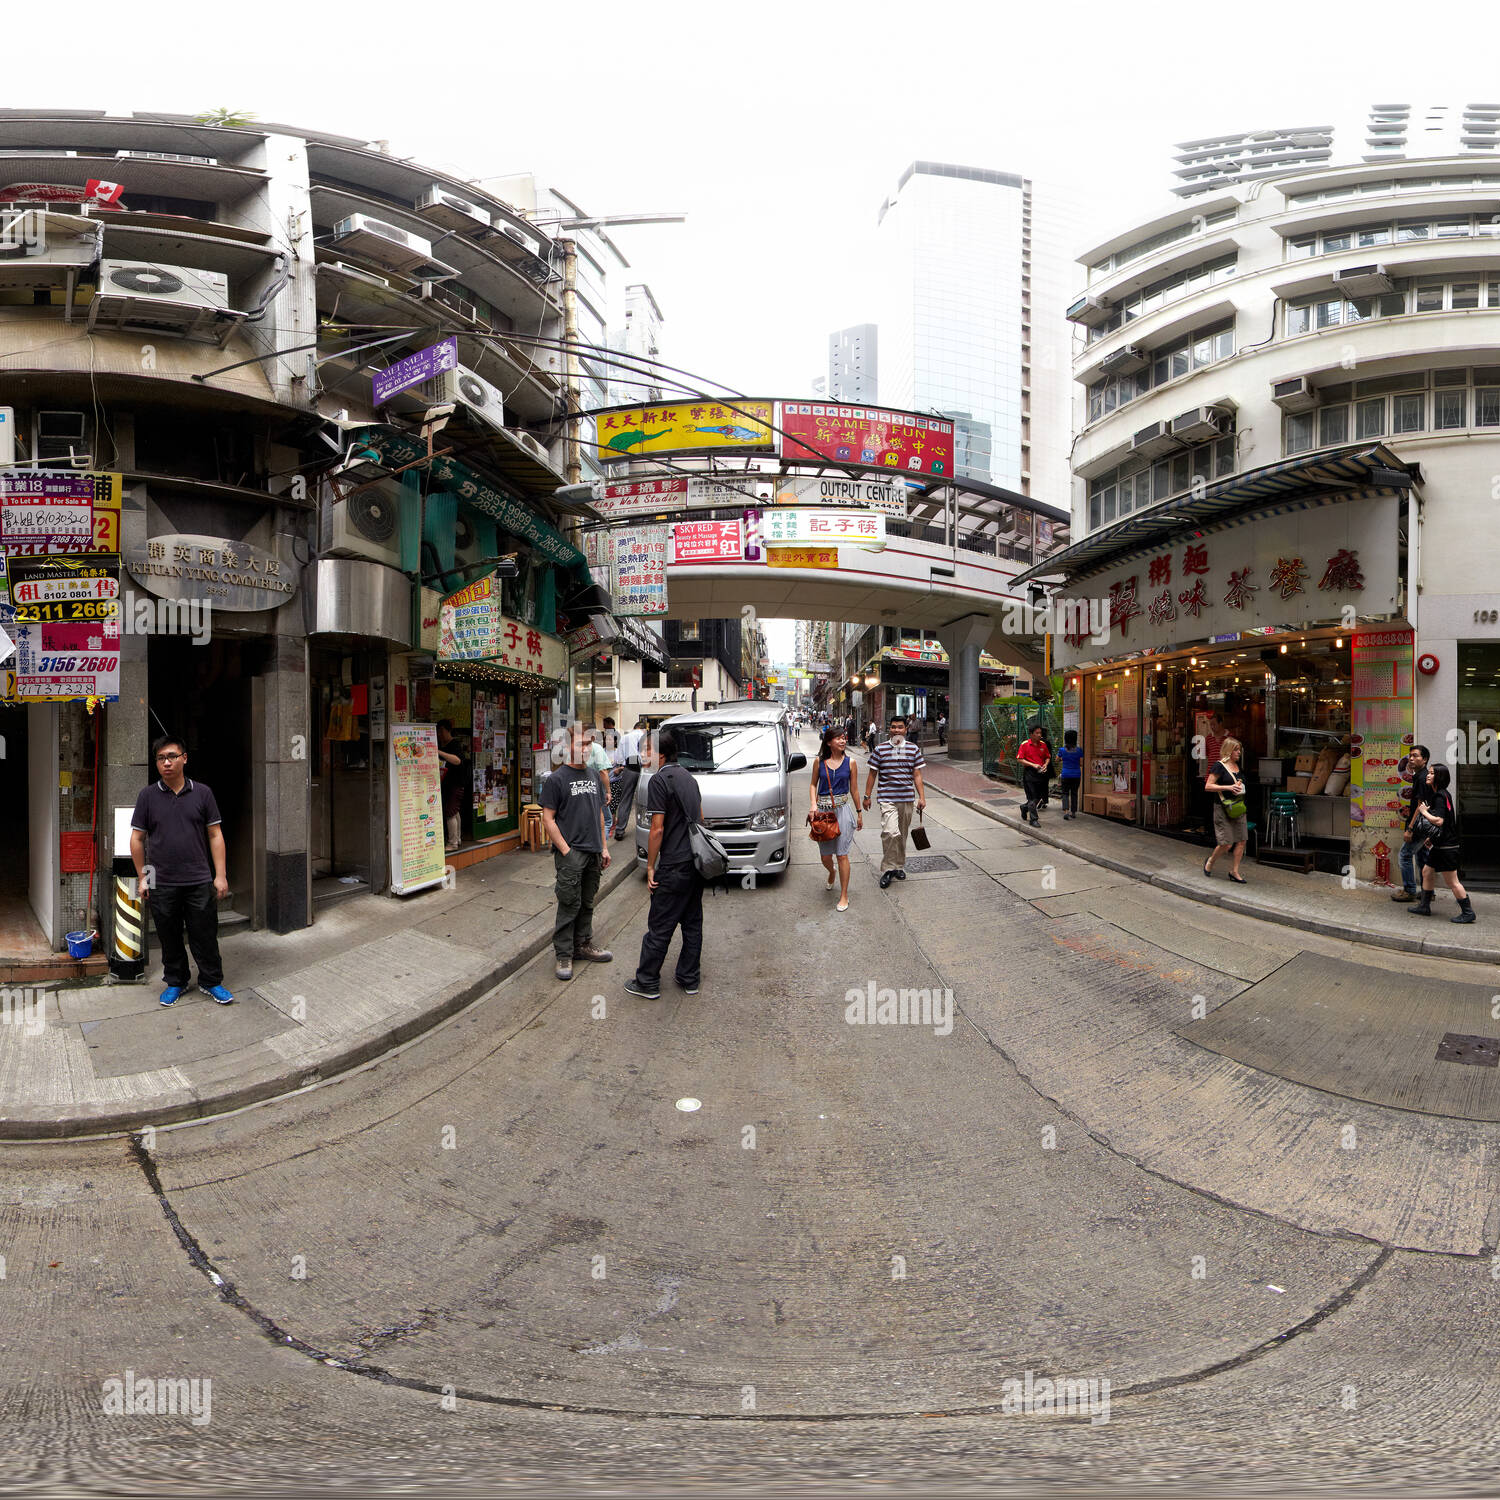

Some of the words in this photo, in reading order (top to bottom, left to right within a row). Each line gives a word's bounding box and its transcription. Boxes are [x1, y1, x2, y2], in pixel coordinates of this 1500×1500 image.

[381, 364, 401, 379] MEI
[403, 353, 424, 367] MEI
[603, 409, 678, 430] 天天新款
[815, 416, 871, 431] GAME
[892, 425, 927, 440] FUN
[643, 493, 678, 505] Studio
[820, 481, 862, 500] OUTPUT
[866, 485, 905, 504] CENTRE
[471, 496, 503, 521] 2854
[479, 485, 508, 510] 2854
[507, 504, 532, 526] 9969
[680, 525, 695, 534] SKY
[697, 523, 713, 533] RED
[148, 541, 281, 577] 群英商業大廈
[617, 553, 649, 564] 送熱飲
[642, 560, 665, 571] $22
[47, 570, 77, 579] MASTER
[131, 561, 183, 578] KHUAN
[185, 566, 219, 583] YING
[1222, 549, 1365, 611] 茶餐廳
[18, 584, 41, 602] 租
[44, 591, 67, 600] 8102
[70, 590, 92, 599] 0801
[95, 579, 116, 598] 售
[618, 593, 649, 605] 送熱飲
[642, 601, 666, 613] $24
[16, 603, 64, 620] 2311
[72, 602, 119, 618] 2668
[39, 656, 77, 673] 3156
[77, 656, 118, 673] 2680
[650, 690, 689, 702] Azelia
